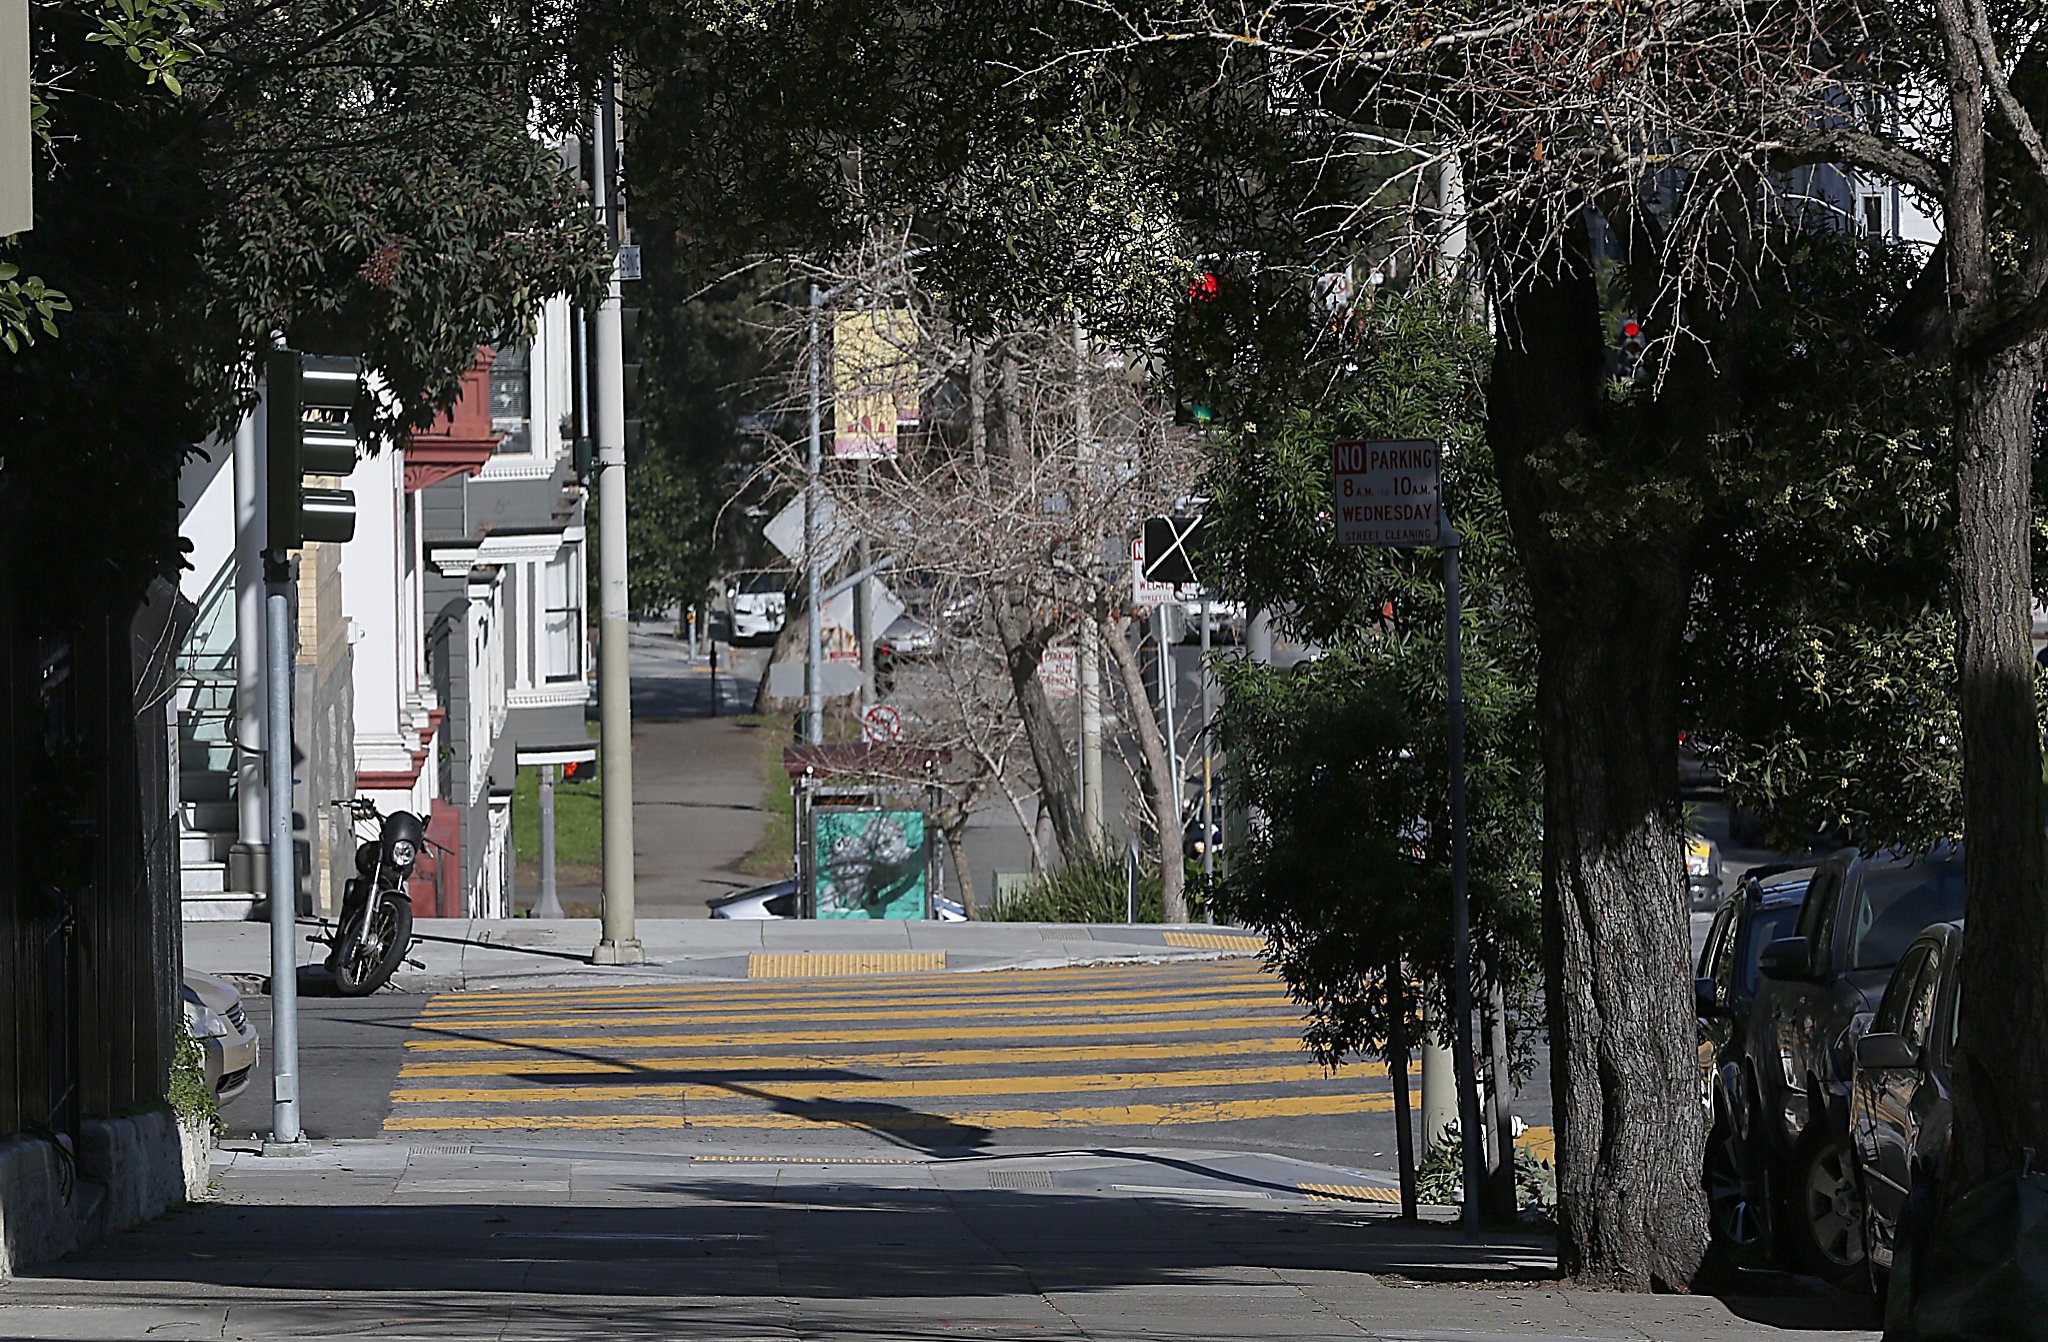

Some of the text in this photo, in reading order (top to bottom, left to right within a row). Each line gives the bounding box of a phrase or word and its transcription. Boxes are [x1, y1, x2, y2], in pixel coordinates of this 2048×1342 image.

[1338, 446, 1432, 471] NO PARKING
[1343, 479, 1354, 497] 8
[1393, 476, 1411, 496] 10
[1343, 504, 1432, 522] WEDNESDAY
[1345, 528, 1431, 541] STREET CLEANING
